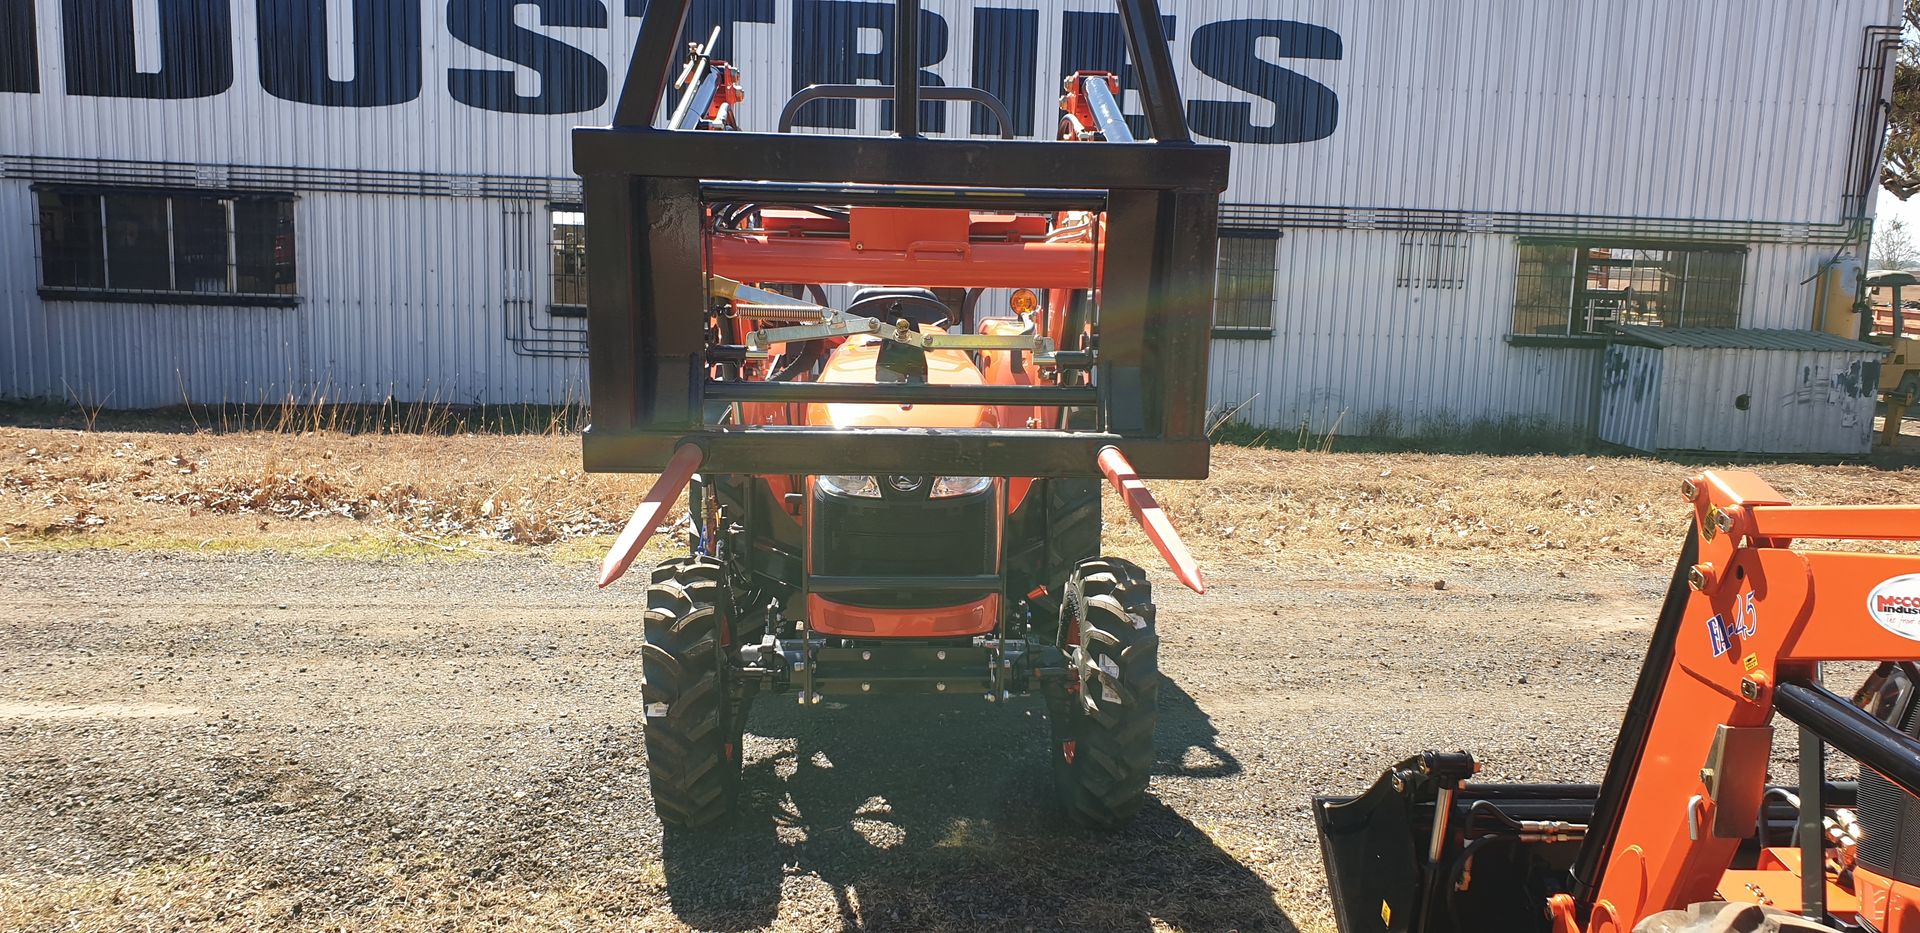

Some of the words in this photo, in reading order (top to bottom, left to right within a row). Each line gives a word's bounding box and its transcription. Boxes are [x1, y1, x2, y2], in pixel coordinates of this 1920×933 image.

[0, 0, 1343, 145] DUSTRIES
[1706, 590, 1757, 657] FA-45
[1884, 605, 1920, 615] indus
